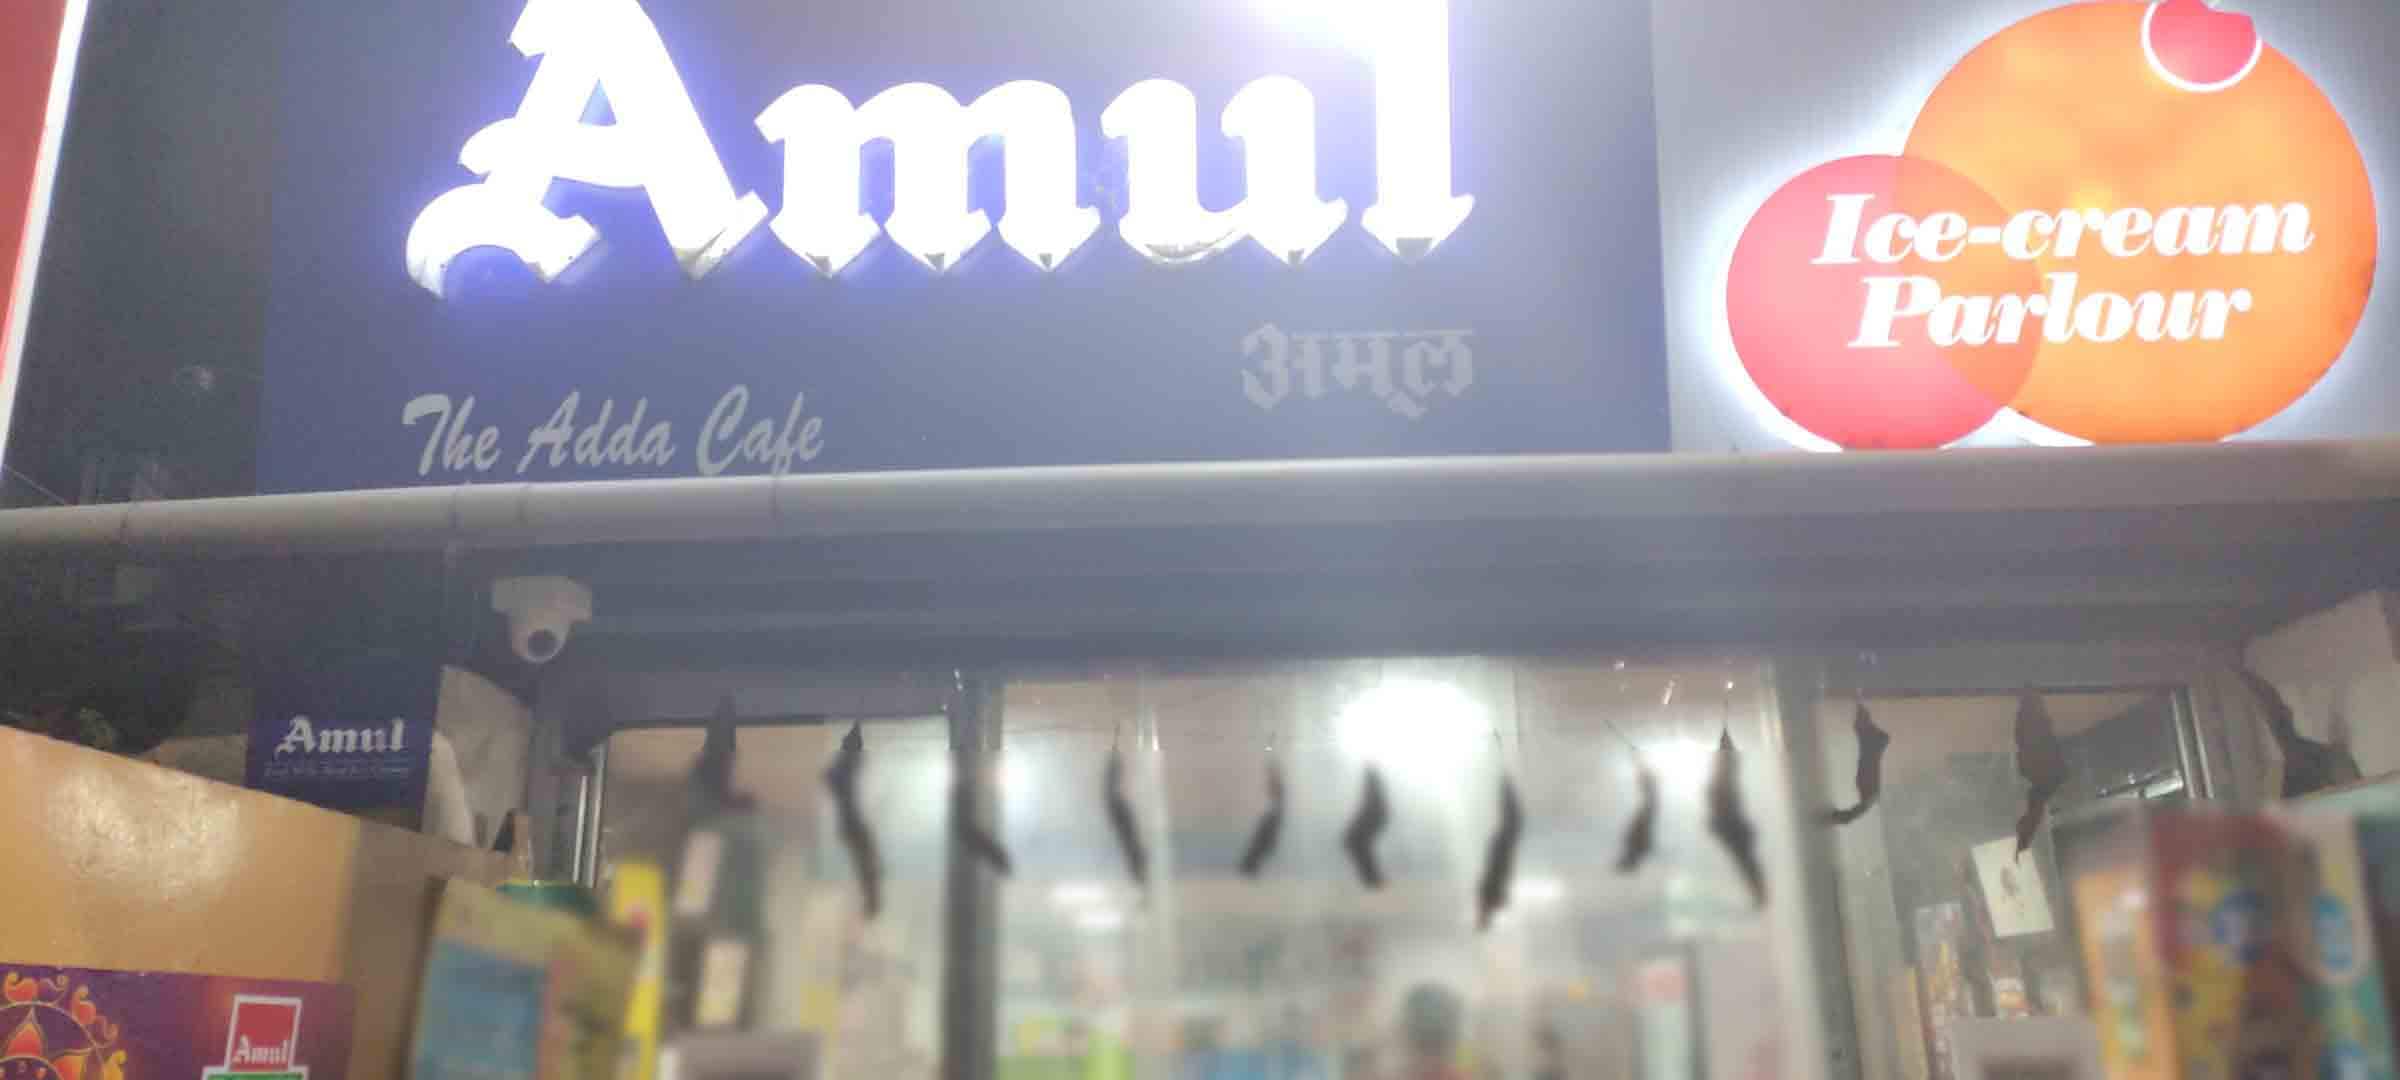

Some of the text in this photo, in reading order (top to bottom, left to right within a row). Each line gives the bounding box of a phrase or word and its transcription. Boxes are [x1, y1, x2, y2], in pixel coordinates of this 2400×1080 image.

[406, 0, 1475, 298] Amul
[1810, 190, 2314, 266] Ice-cream
[1847, 272, 2253, 349] Parlour
[402, 384, 824, 477] The Adda Cafe
[273, 714, 406, 759] Amul
[232, 1034, 293, 1065] Amul
